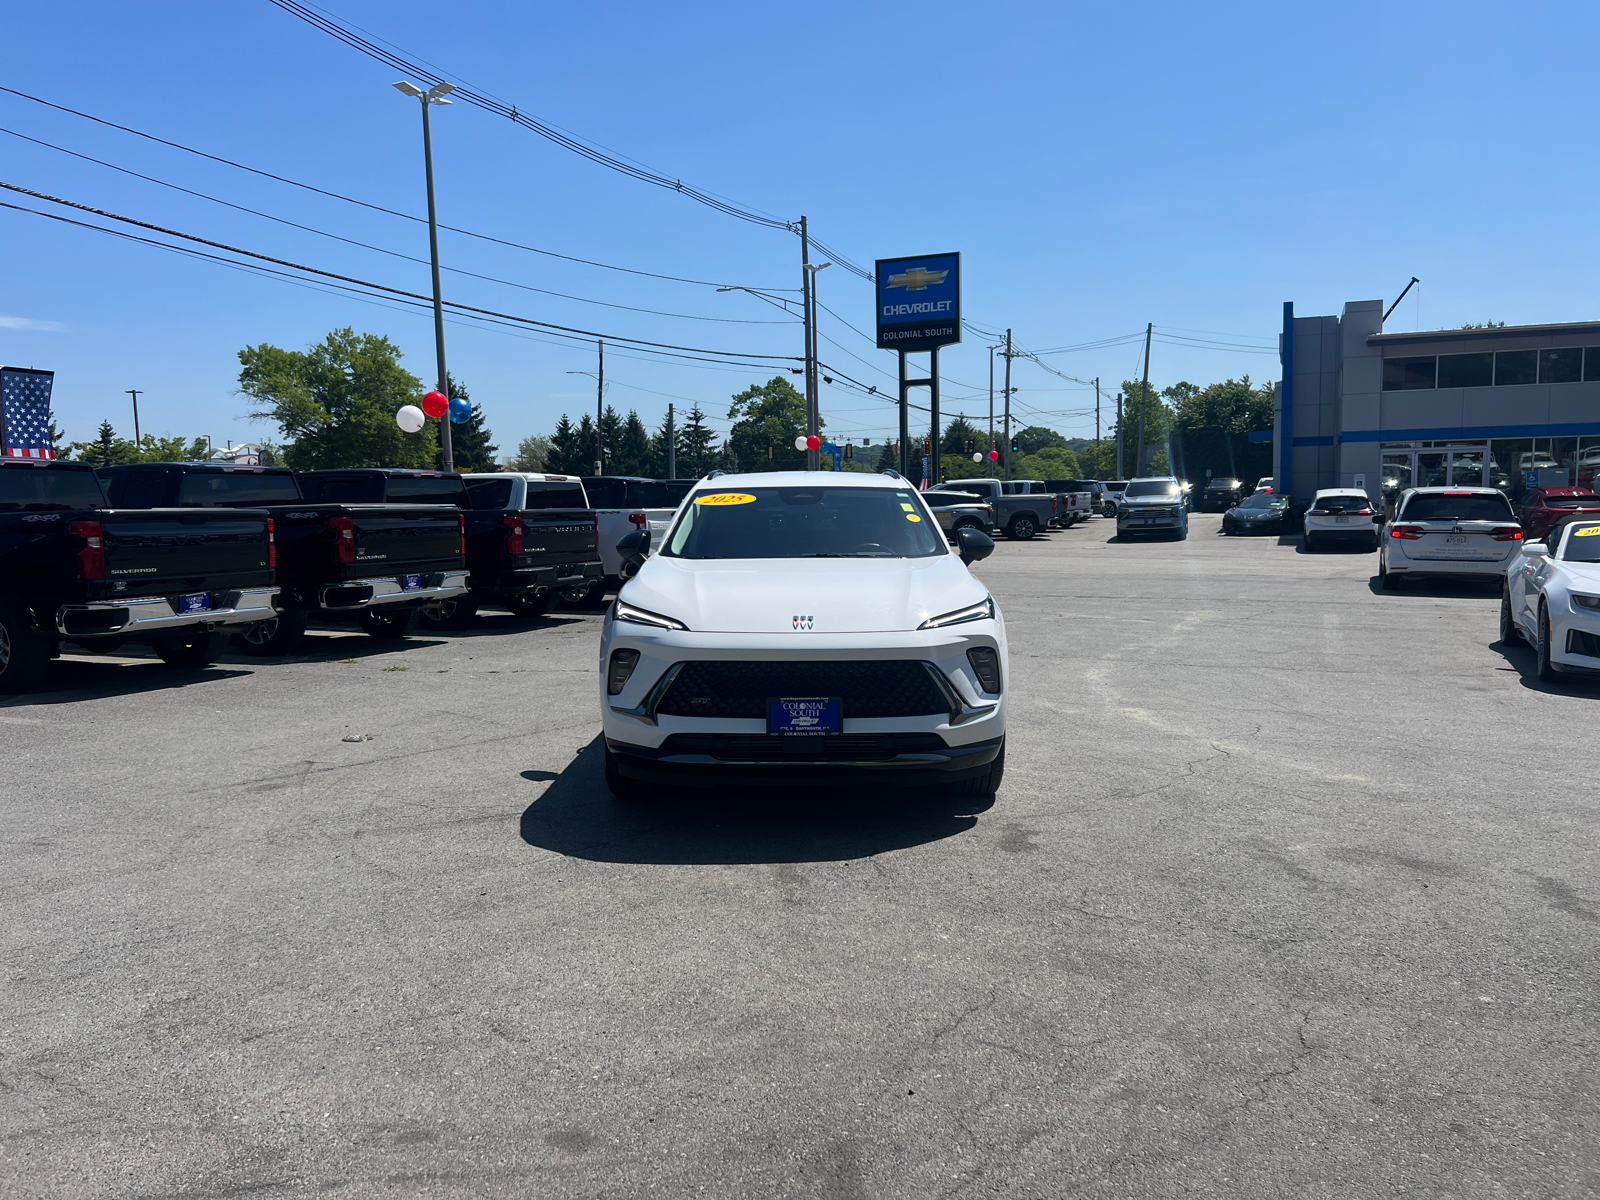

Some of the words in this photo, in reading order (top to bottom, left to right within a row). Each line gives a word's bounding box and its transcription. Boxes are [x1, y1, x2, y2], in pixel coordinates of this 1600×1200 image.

[883, 301, 952, 316] CHEVROLET
[883, 330, 923, 340] COLONIAL
[925, 328, 953, 337] SOUTH
[703, 495, 746, 503] 2025
[782, 702, 826, 710] COLONIAL
[789, 709, 819, 717] SOUTH
